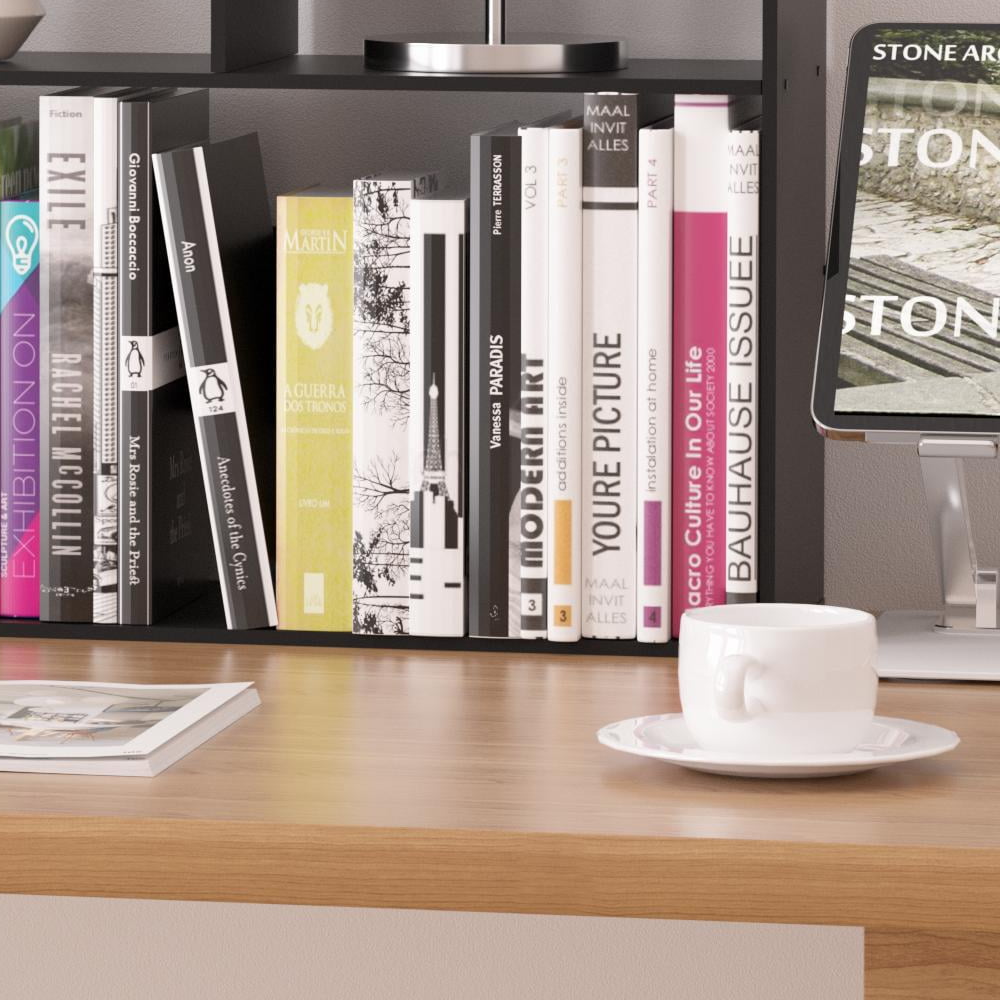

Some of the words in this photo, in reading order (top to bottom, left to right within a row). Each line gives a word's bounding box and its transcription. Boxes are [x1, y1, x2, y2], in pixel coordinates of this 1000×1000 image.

[872, 44, 957, 61] STONE
[962, 44, 1000, 62] AR
[49, 110, 83, 118] Fiction
[586, 105, 631, 117] MAAL
[590, 122, 627, 134] INVIT
[587, 139, 629, 151] ALLES
[525, 164, 537, 174] 3
[648, 159, 657, 167] 4
[729, 163, 758, 176] NVIT
[47, 153, 86, 230] EXILE
[128, 153, 141, 212] Giovanni
[492, 154, 502, 207] TERRASSON
[525, 179, 537, 210] VOL
[648, 172, 657, 208] PART
[493, 209, 501, 235] Pierre
[128, 215, 141, 281] Boccaccio
[181, 240, 197, 273] Anon
[283, 230, 348, 251] MARTIN
[728, 235, 753, 367] ISSUEE
[12, 313, 36, 368] ON
[489, 334, 503, 396] PARADIS
[646, 348, 657, 392] home
[685, 345, 702, 383] Life
[705, 347, 716, 373] 2000
[51, 353, 83, 434] RACHEL
[294, 384, 345, 398] GUERRA
[521, 353, 544, 415] ART
[555, 376, 567, 419] inside
[593, 333, 621, 451] PICTURE
[705, 374, 716, 417] SOCIETY
[647, 402, 657, 412] at
[685, 390, 702, 432] Our
[490, 402, 501, 450] Vanessa
[705, 418, 716, 453] ABOUT
[129, 435, 141, 460] Mrs
[556, 427, 567, 491] additions
[686, 438, 702, 459] In
[12, 381, 36, 579] EXHIBITION
[129, 463, 141, 498] Rosie
[217, 456, 237, 515] Anecdotes
[705, 456, 716, 491] KNOW
[728, 382, 753, 582] BAUHAUSE
[51, 447, 83, 556] MCCOLLIN
[129, 500, 141, 522] and
[521, 427, 544, 568] MODERN
[593, 461, 621, 557] YOURE
[685, 465, 702, 547] Culture
[705, 492, 716, 507] TO
[1, 513, 8, 521] &
[227, 516, 240, 530] of
[129, 524, 141, 545] the
[229, 529, 243, 551] the
[705, 540, 716, 562] YOU
[232, 552, 247, 591] Cynics
[585, 578, 628, 590] MAAL
[688, 553, 702, 607] acro
[528, 600, 537, 611] 3
[559, 610, 567, 622] 3
[589, 595, 625, 606] INVIT
[648, 610, 656, 622] 4
[586, 612, 627, 624] ALLES
